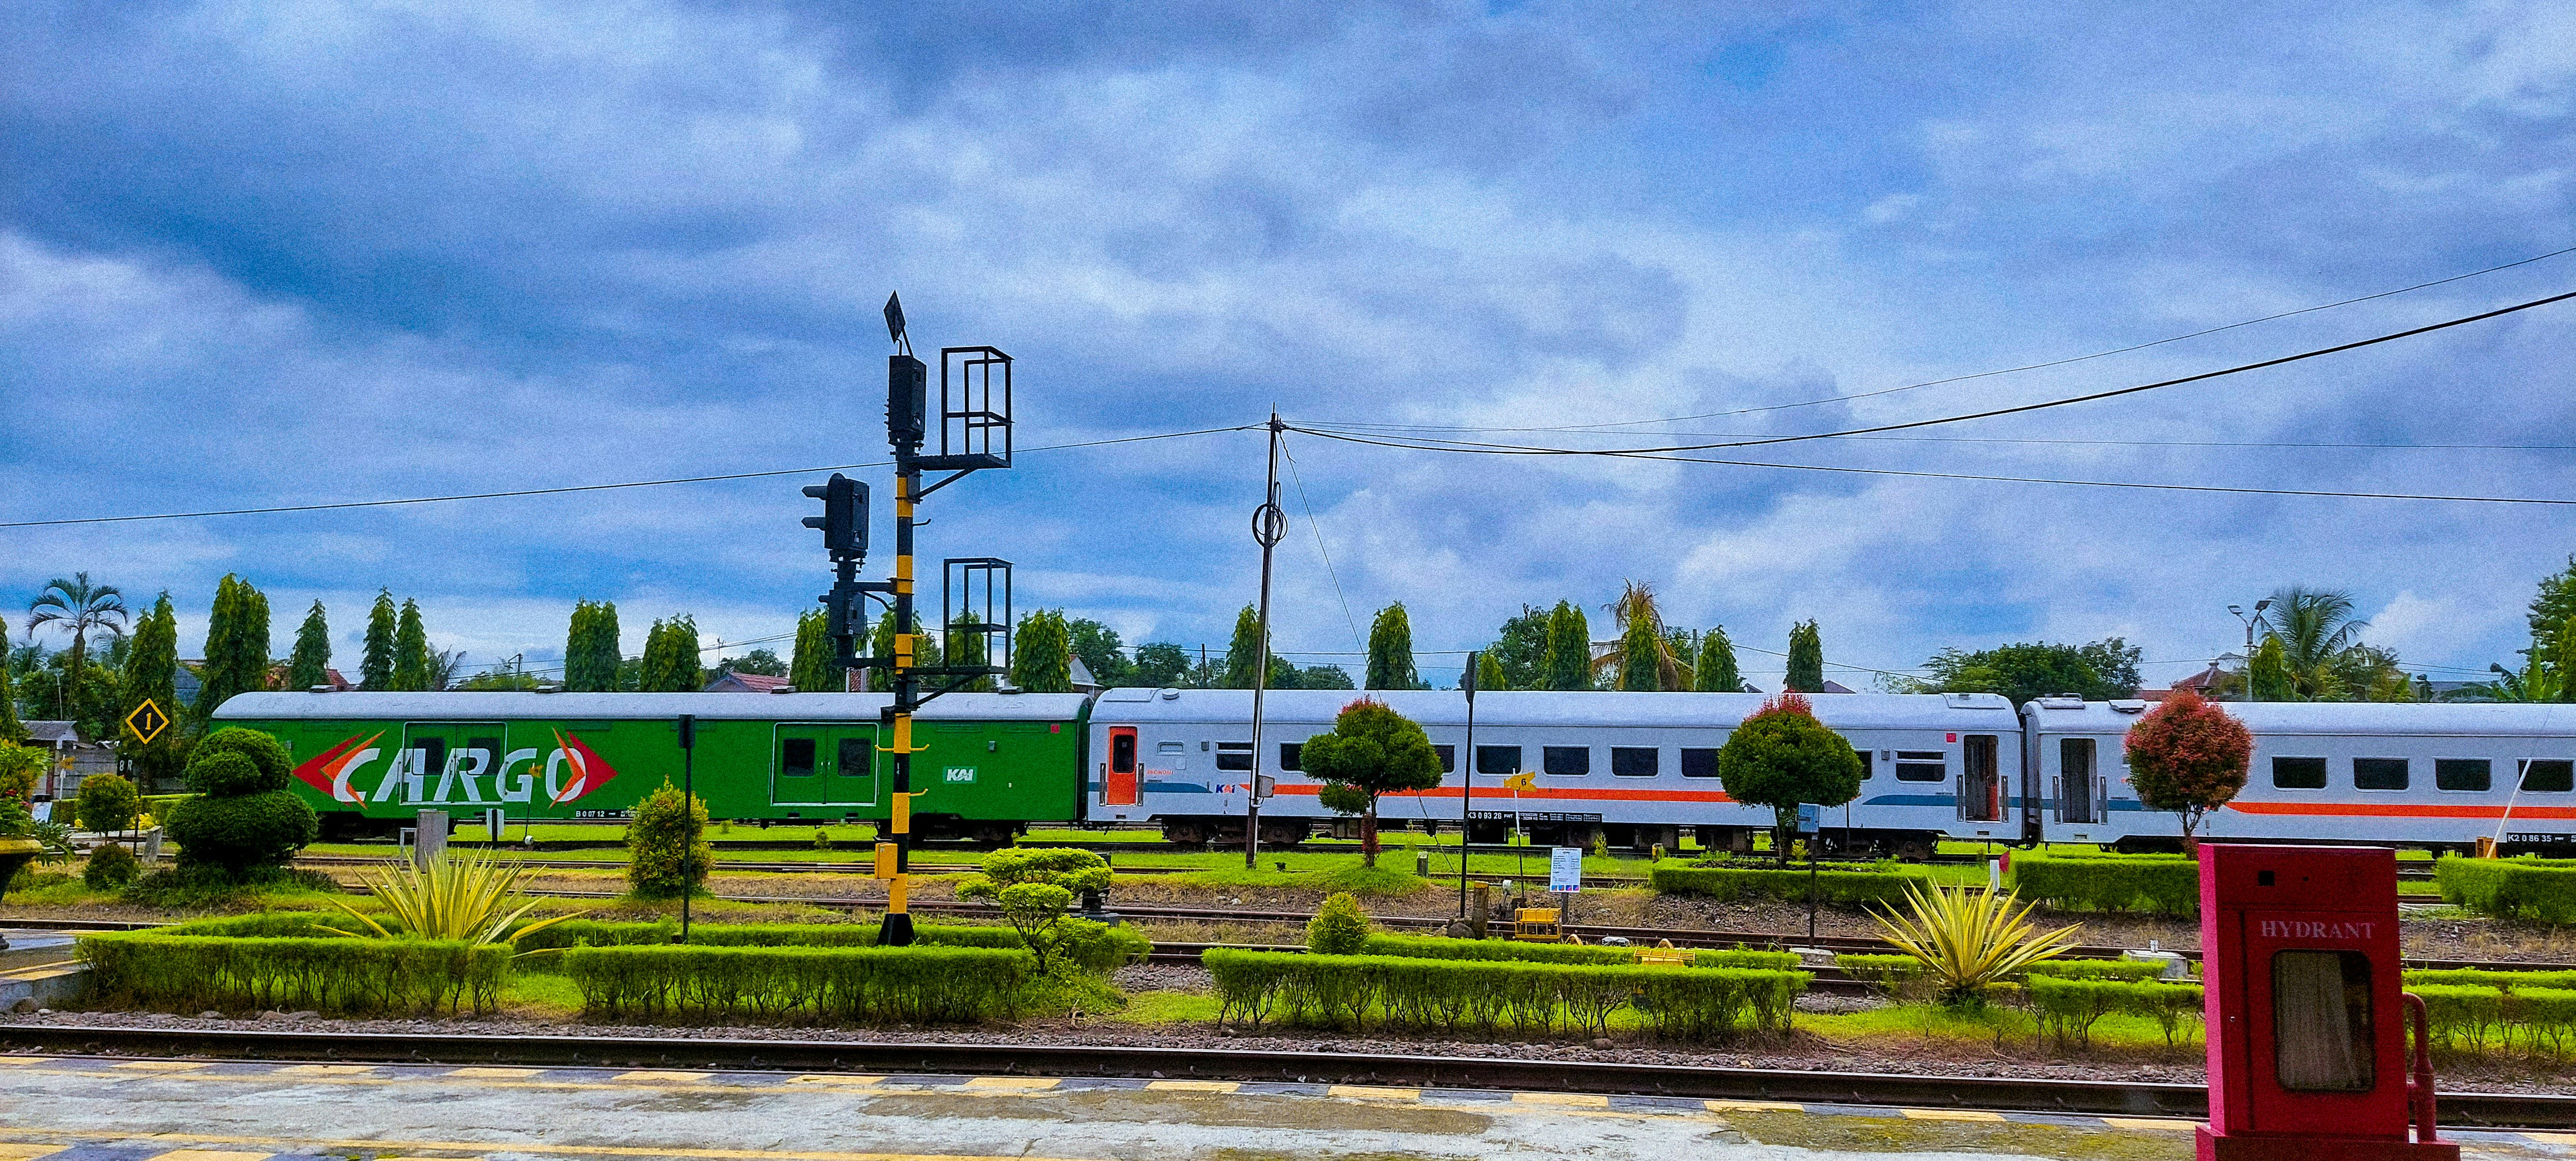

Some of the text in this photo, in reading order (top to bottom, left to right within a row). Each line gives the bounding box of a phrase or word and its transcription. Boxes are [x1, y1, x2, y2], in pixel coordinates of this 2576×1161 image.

[145, 713, 152, 730] 1
[119, 759, 133, 771] 8 R
[333, 748, 587, 802] CARGO
[947, 769, 974, 781] KAI
[1216, 784, 1235, 793] KAI
[2261, 920, 2375, 939] HYDRANT
